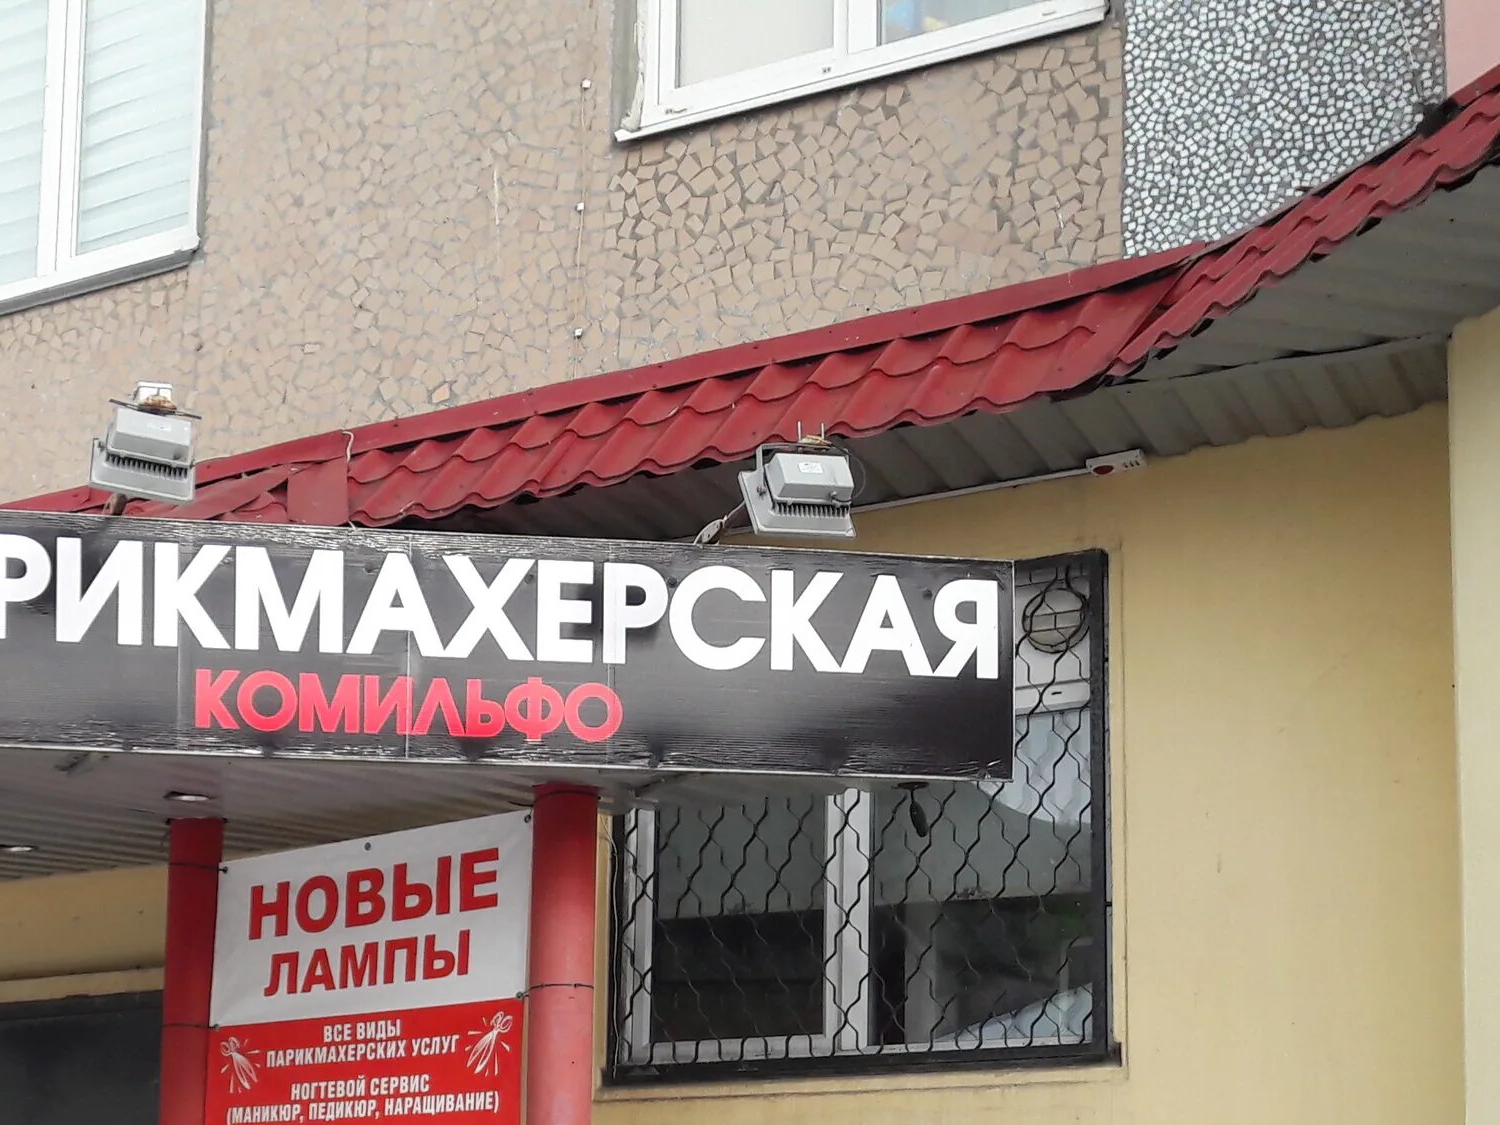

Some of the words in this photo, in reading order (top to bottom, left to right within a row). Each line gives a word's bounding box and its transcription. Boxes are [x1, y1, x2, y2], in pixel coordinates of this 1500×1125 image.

[194, 667, 624, 743] КОМИЛЬФО
[248, 847, 500, 941] НОВЫЕ
[263, 929, 471, 998] ЛАМПЫ
[323, 1023, 352, 1043] ВСЕ
[356, 1019, 401, 1040] ВИДЫ
[266, 1040, 406, 1068] ПАРИКМАХЕРСКИХ
[411, 1035, 460, 1055] УСЛУГ
[290, 1075, 366, 1100] НОГТЕВОЙ
[370, 1074, 430, 1096] СЕРВИС
[308, 1098, 380, 1121] ПЕДИКЮР,
[384, 1091, 499, 1116] НАРАЩИВАНИЕ)
